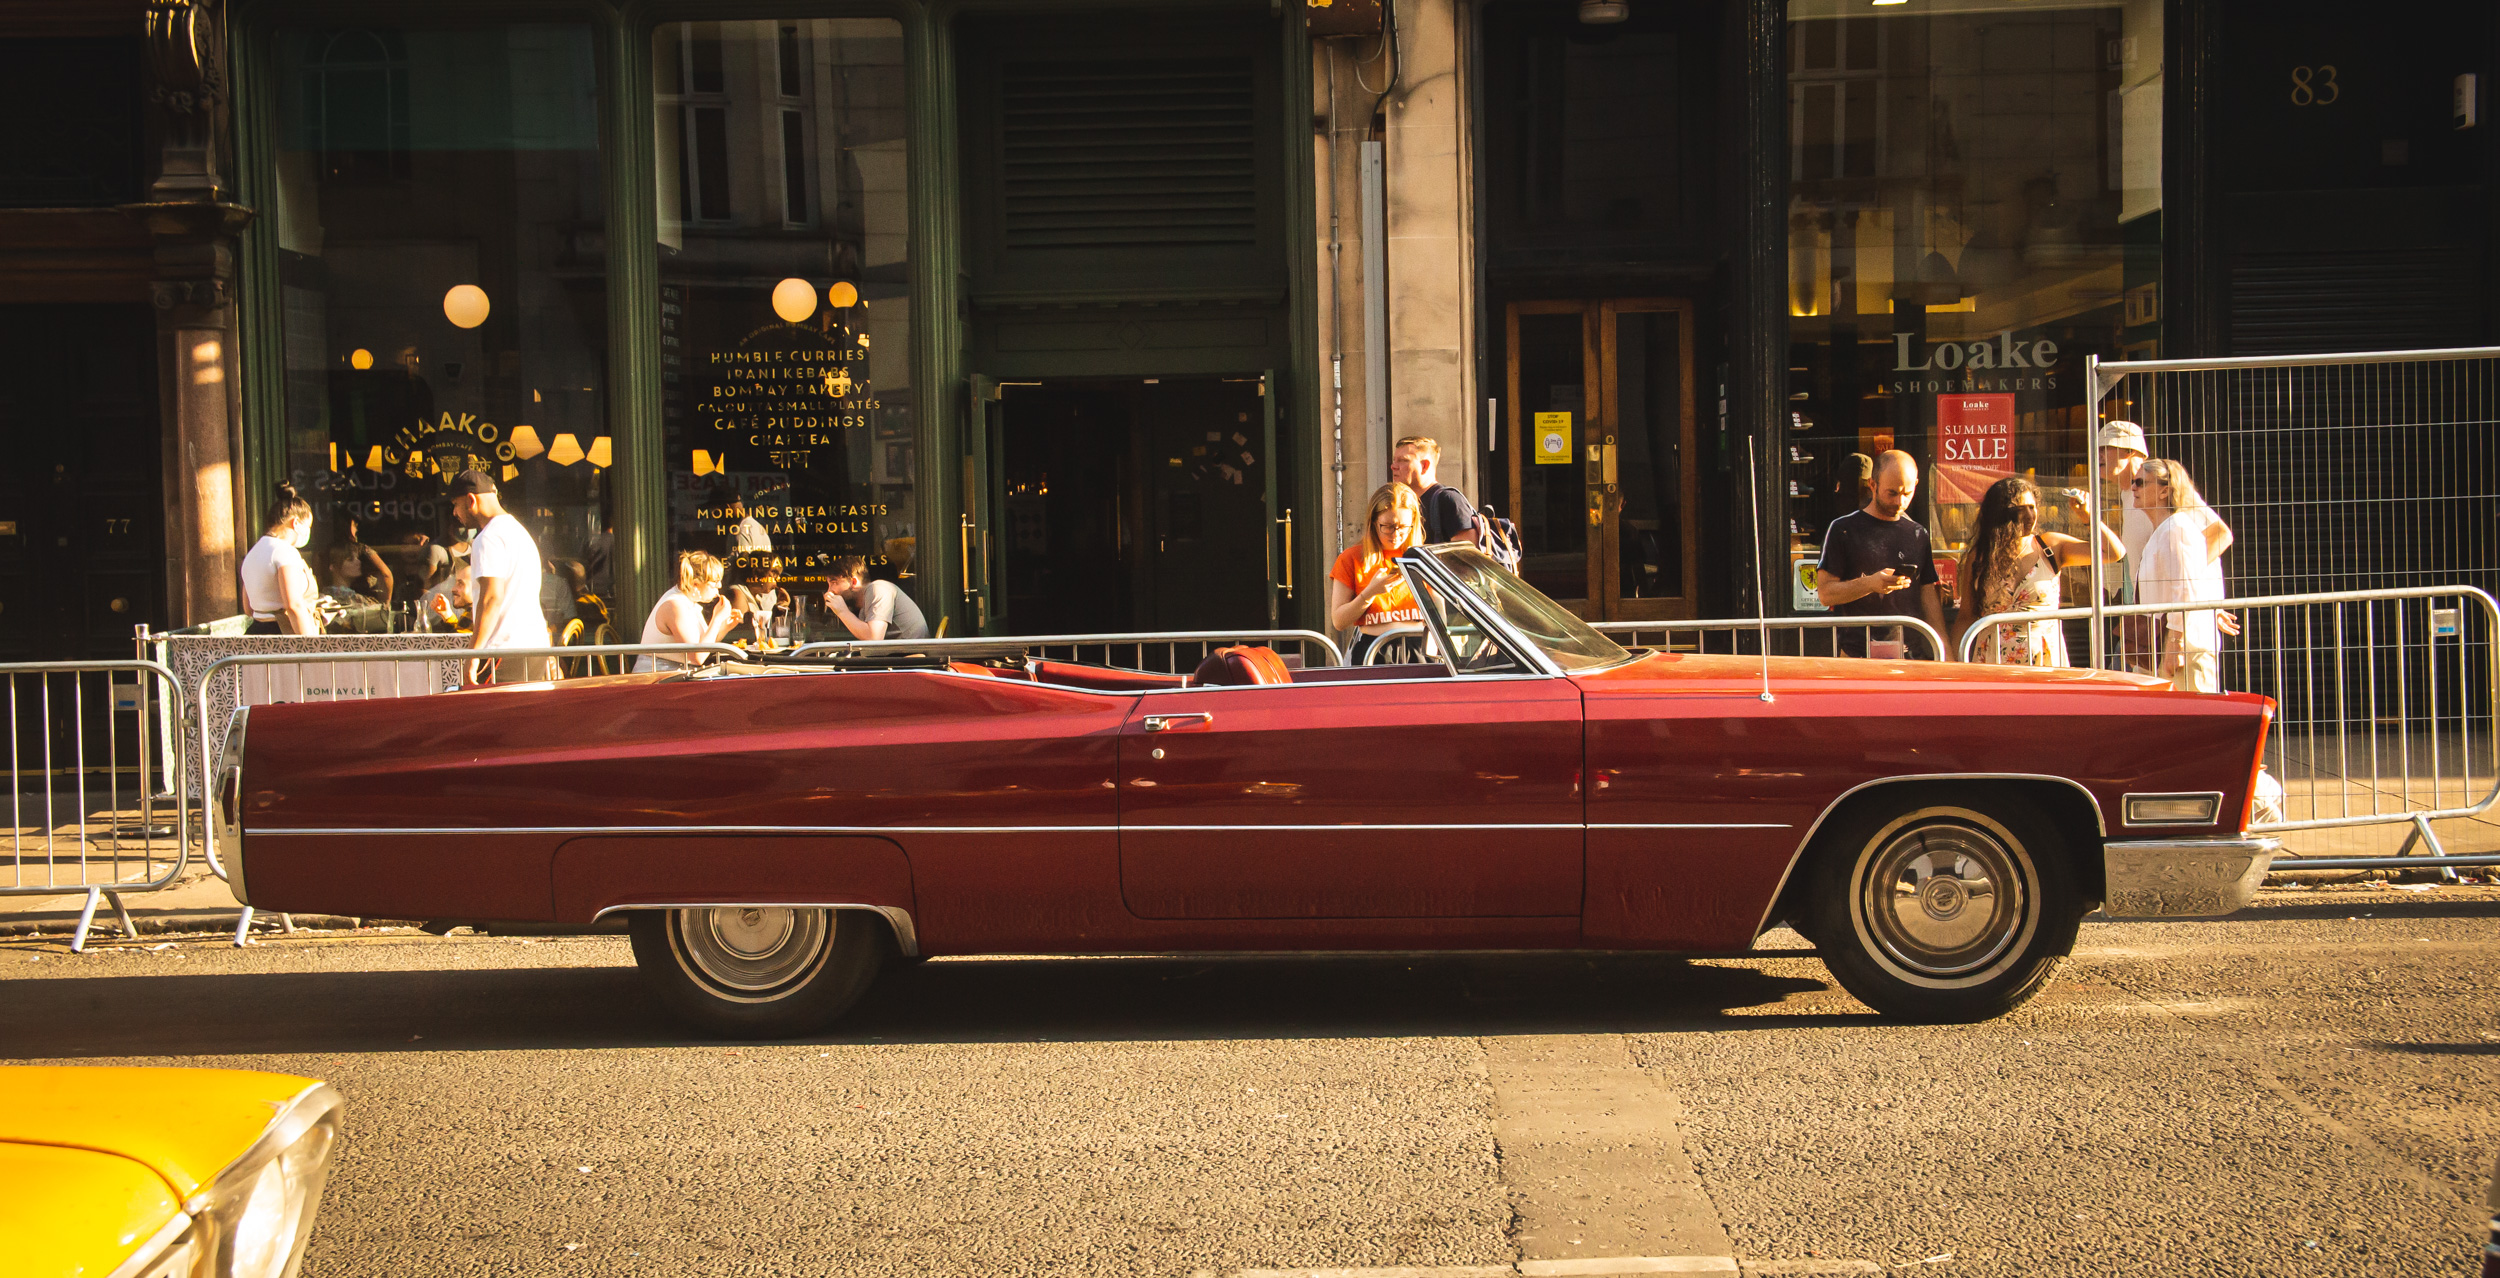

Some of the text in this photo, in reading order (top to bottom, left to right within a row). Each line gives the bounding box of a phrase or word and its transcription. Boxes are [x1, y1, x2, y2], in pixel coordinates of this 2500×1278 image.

[2290, 64, 2339, 106] 83
[711, 349, 864, 363] HUMBLE CURRIES
[1892, 330, 2058, 371] Loake
[727, 366, 849, 380] IRANI KEBABS
[713, 382, 864, 397] BOMBAY BAKERY
[1894, 377, 2057, 394] SHOEMAKERS
[697, 402, 773, 412] CALCUTTA
[778, 401, 825, 411] SMALL
[714, 414, 865, 430] CAFÉ PUDDINGS
[1945, 424, 2008, 435] SUMMER
[384, 411, 516, 464] CHAAKOO
[750, 433, 830, 446] CHAI TEA
[1945, 438, 2008, 460] SALE
[769, 450, 811, 469] चाय
[697, 504, 888, 519] MORNING BREAKFASTS
[106, 518, 131, 534] 77
[717, 523, 751, 536] HOT
[736, 556, 798, 569] CREAM
[805, 556, 815, 567] &
[823, 554, 888, 567] SKES
[351, 685, 376, 696] CAÉ
